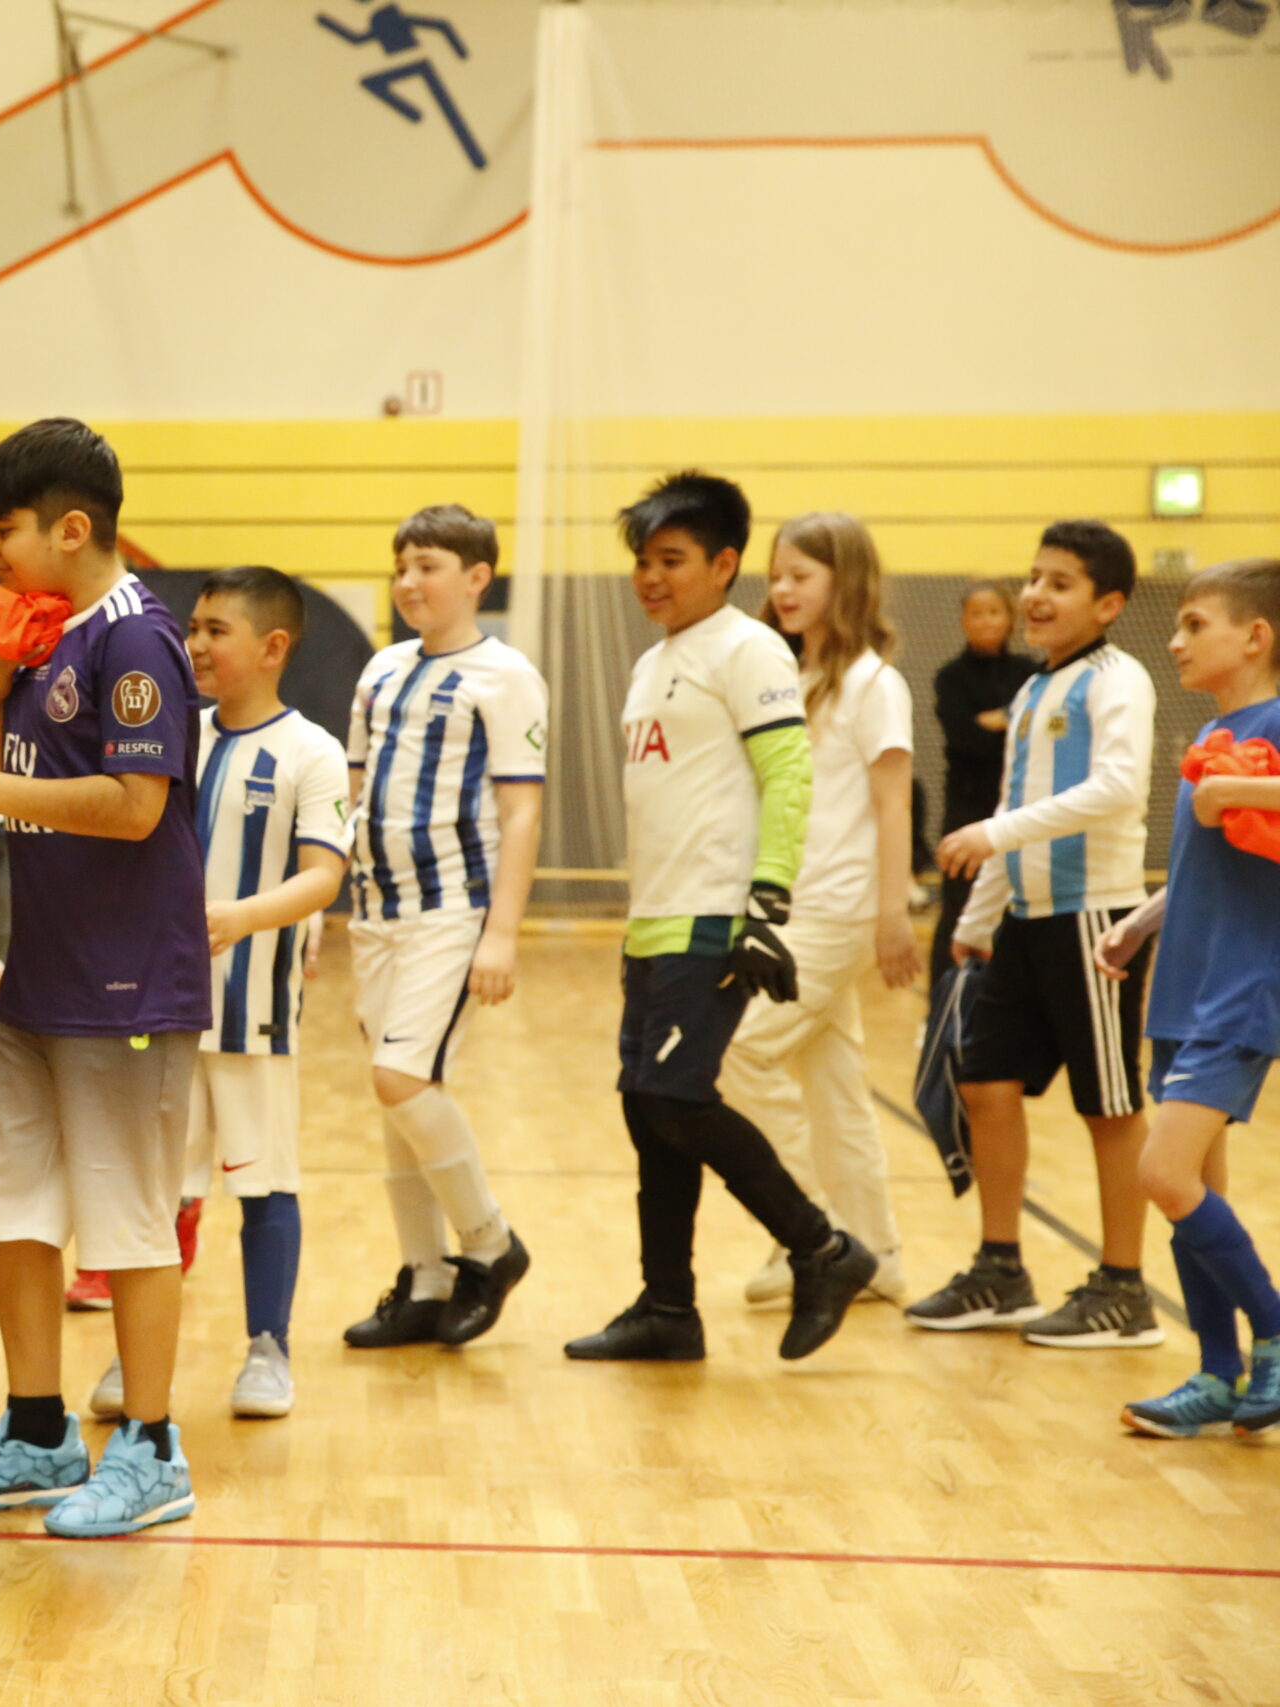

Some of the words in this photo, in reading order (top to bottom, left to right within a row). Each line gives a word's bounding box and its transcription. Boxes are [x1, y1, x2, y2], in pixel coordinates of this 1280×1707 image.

[127, 695, 143, 709] 11
[3, 732, 38, 778] Fly
[117, 742, 164, 755] RESPECT
